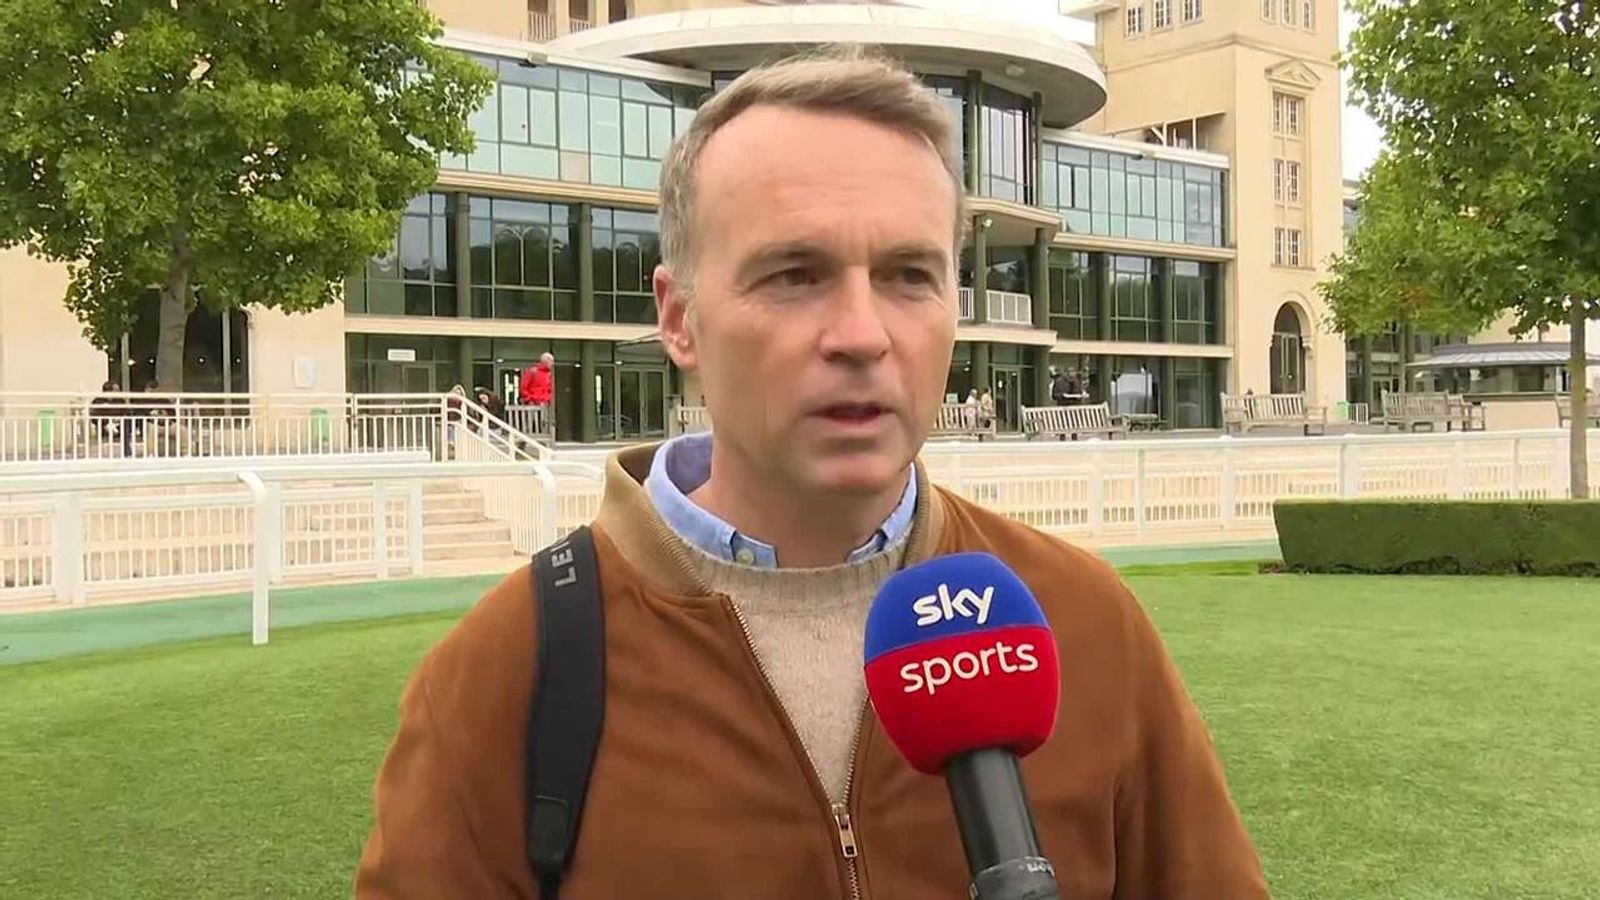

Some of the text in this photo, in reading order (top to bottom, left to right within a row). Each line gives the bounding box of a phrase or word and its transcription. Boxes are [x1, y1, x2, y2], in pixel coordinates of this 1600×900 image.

[550, 541, 577, 587] LE
[912, 583, 995, 627] sky
[900, 641, 1039, 695] sports
